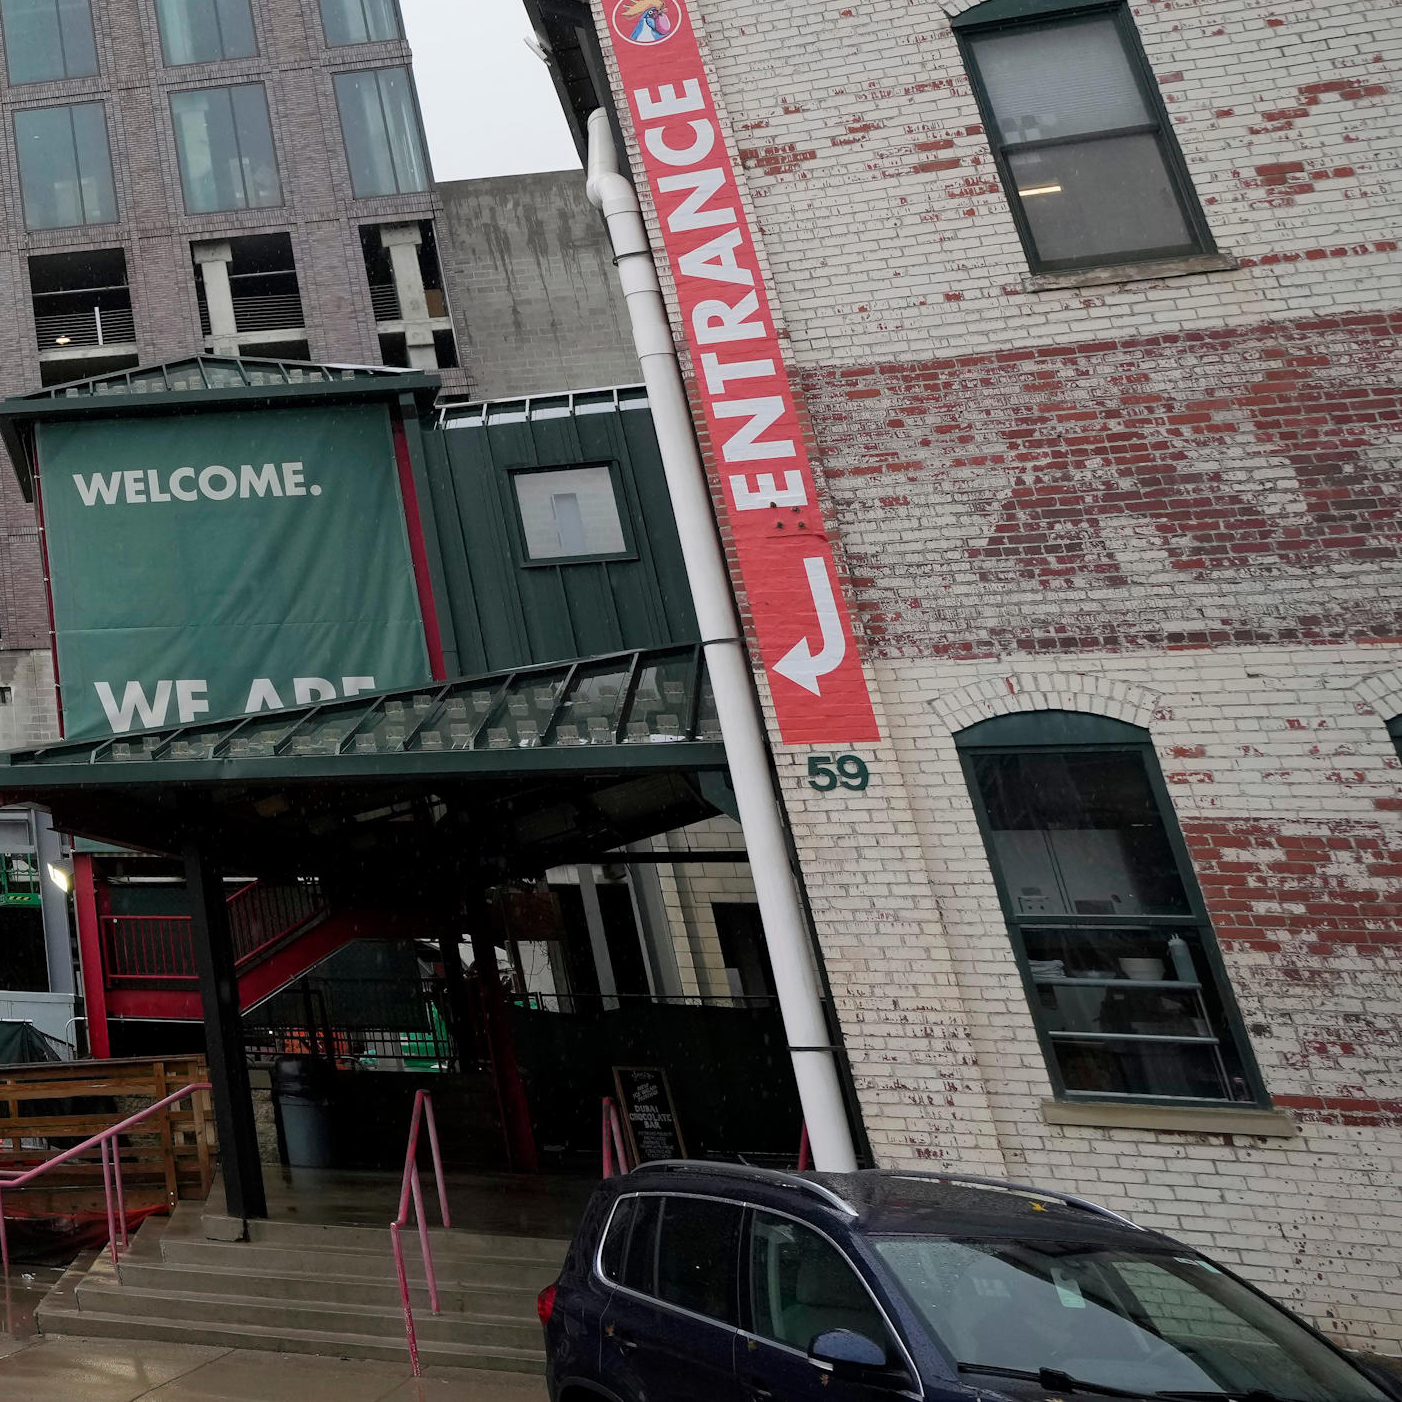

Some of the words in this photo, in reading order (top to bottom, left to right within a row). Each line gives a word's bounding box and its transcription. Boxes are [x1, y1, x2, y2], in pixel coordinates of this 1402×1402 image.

[633, 78, 808, 511] ENTRANCE
[72, 461, 323, 507] WELCOME.
[806, 753, 870, 792] 59
